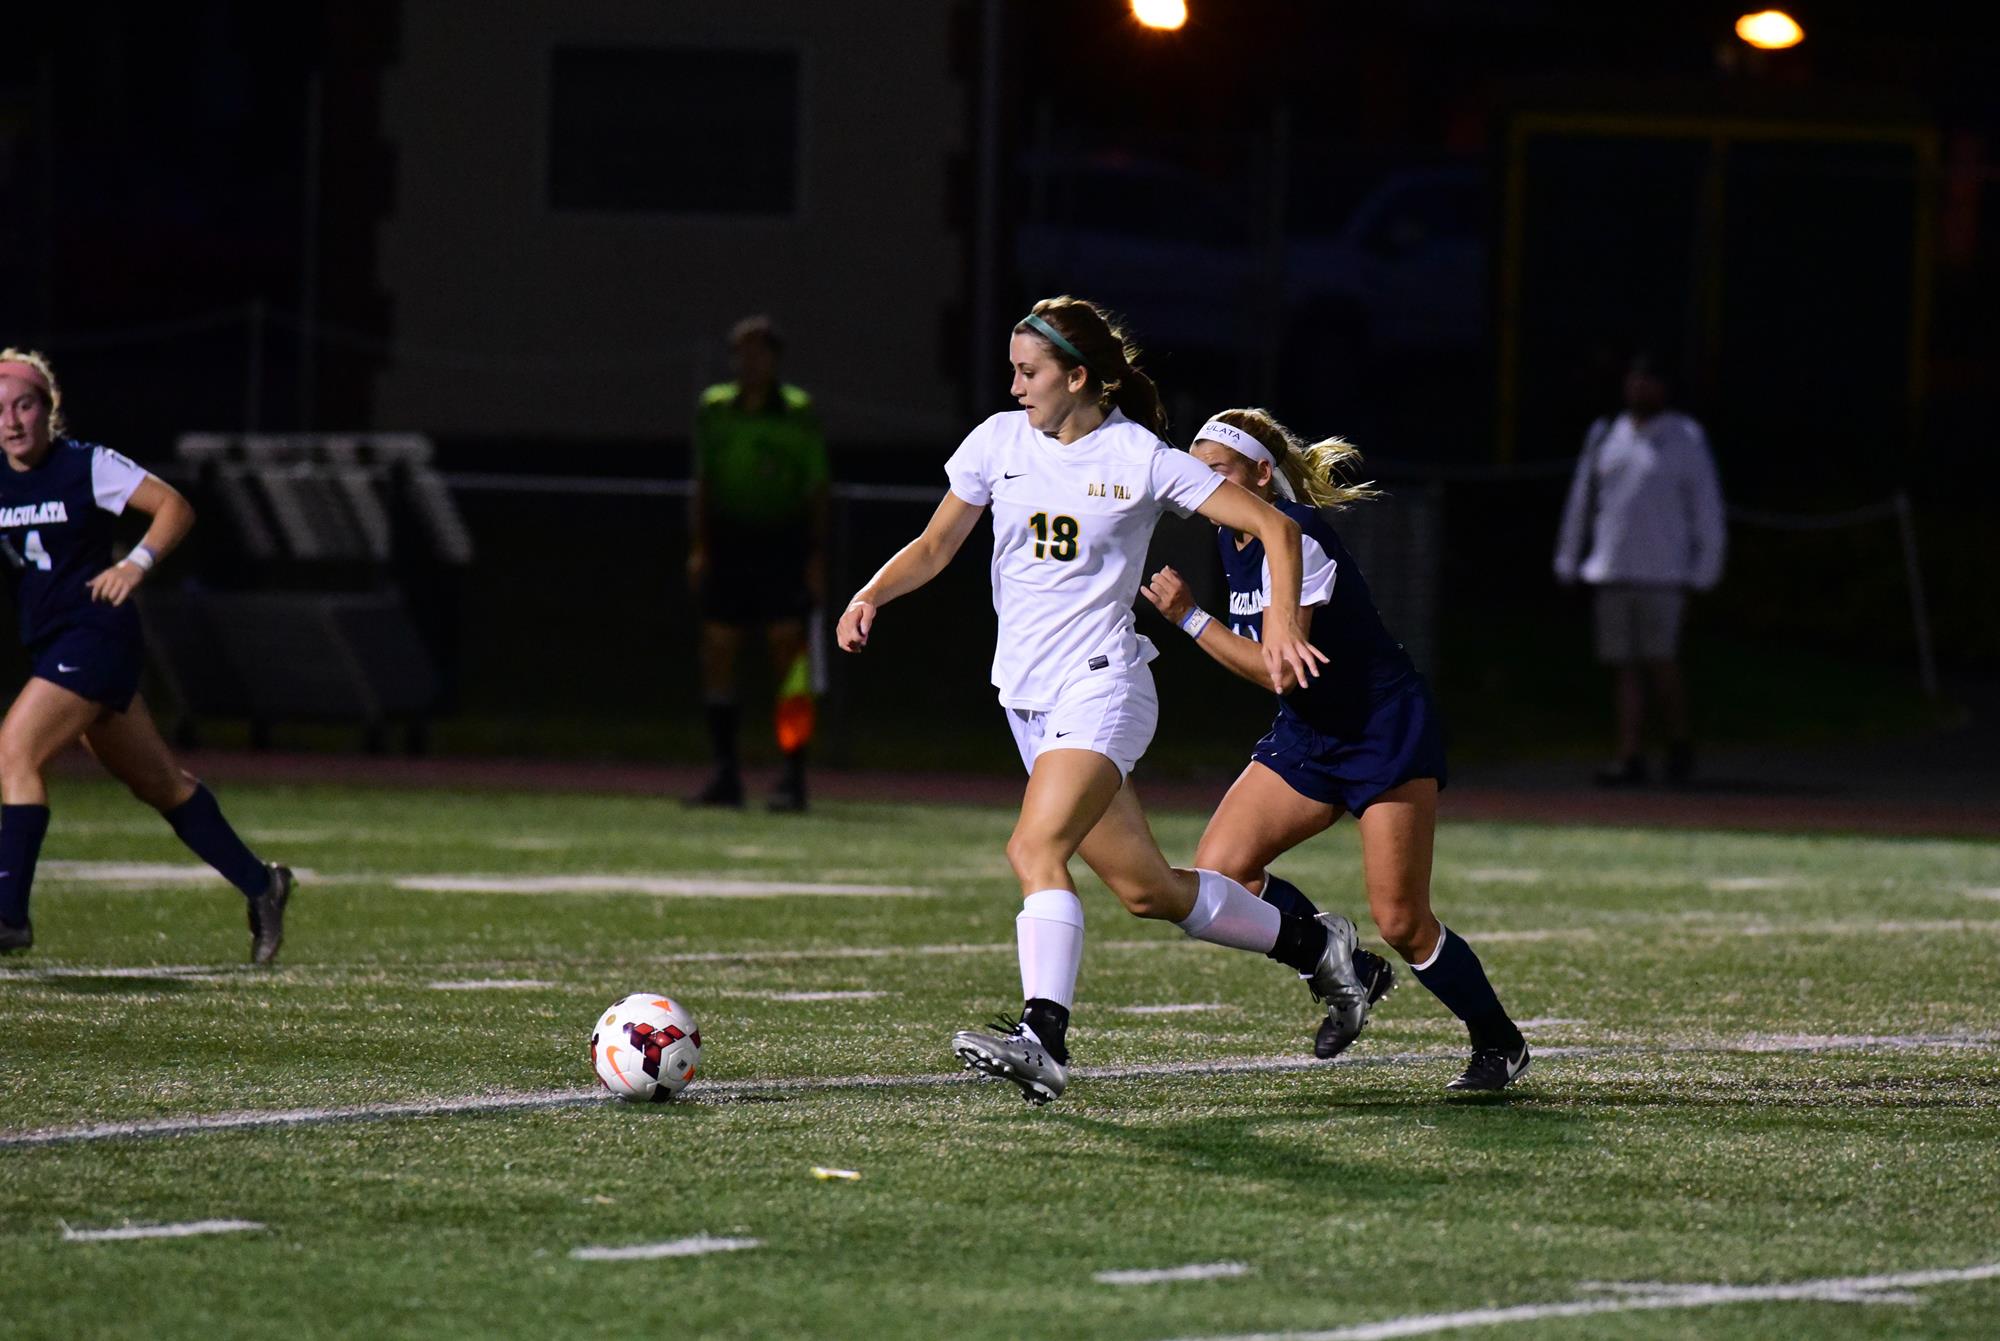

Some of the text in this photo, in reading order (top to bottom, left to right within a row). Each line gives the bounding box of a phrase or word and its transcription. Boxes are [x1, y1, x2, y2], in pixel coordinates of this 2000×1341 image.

[1206, 424, 1240, 441] ULATA
[1113, 484, 1131, 500] VAL
[1028, 511, 1080, 563] 18
